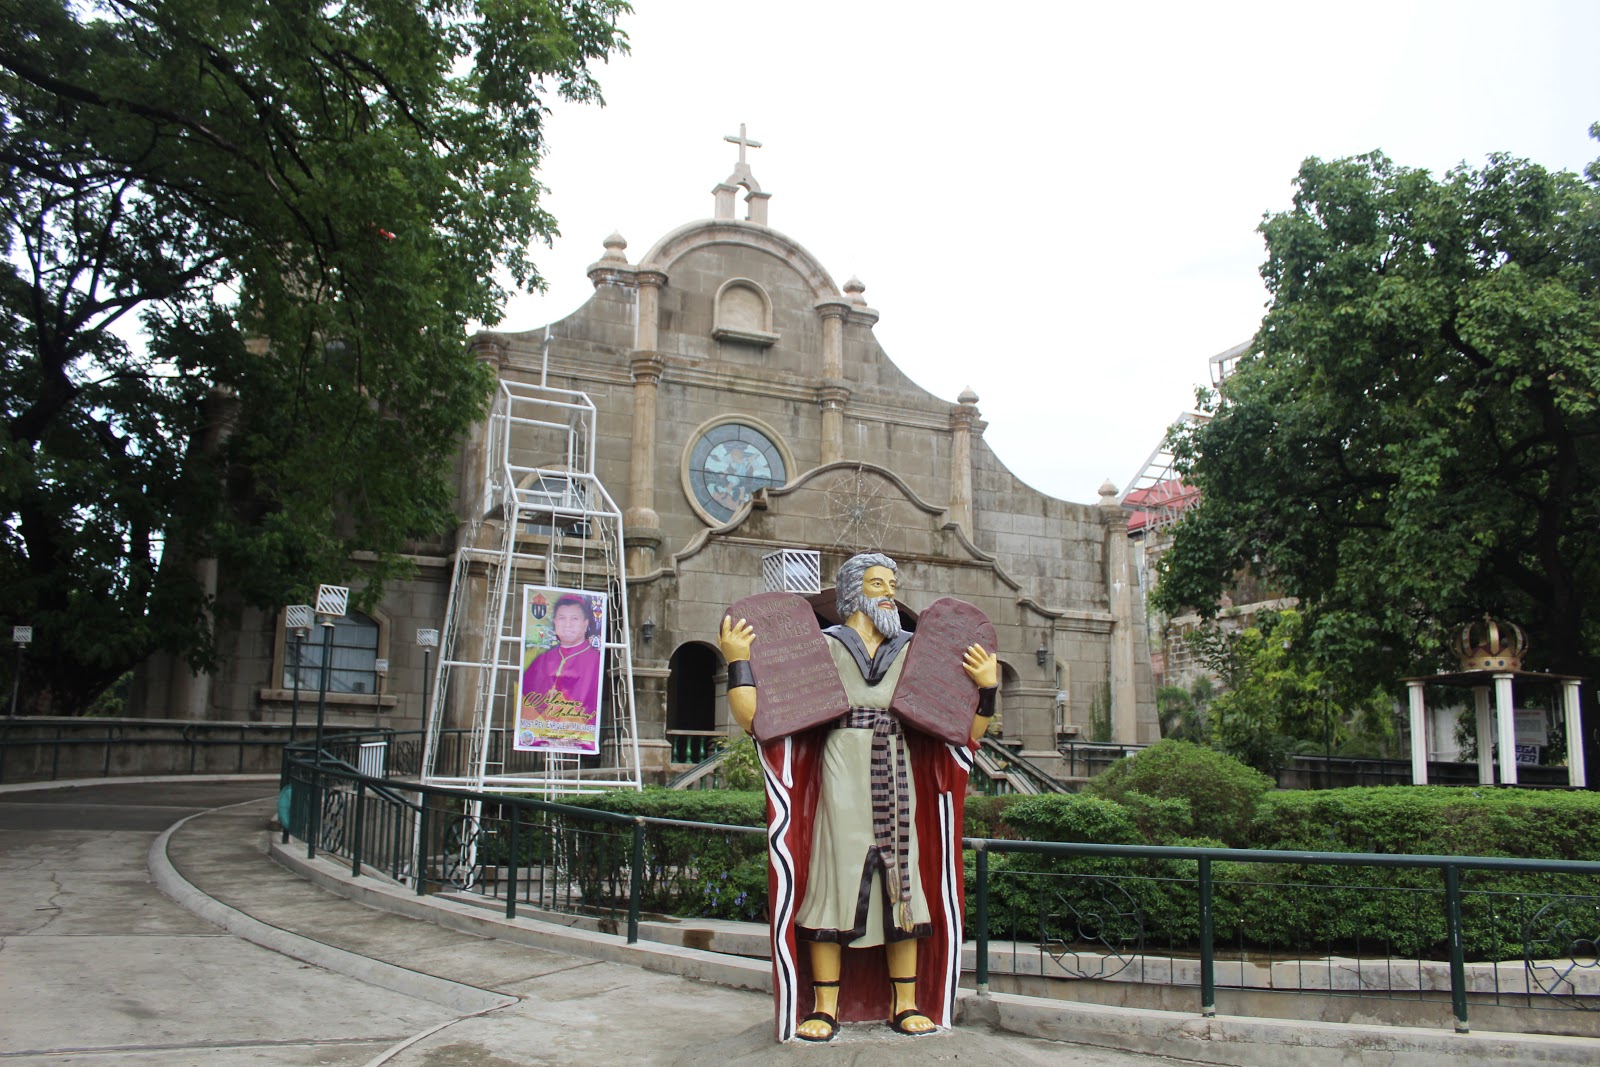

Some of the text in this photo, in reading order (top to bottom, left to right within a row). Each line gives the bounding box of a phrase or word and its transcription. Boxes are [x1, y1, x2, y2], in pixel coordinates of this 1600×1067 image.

[758, 610, 792, 630] UTOS
[775, 622, 812, 639] DIYOS
[523, 691, 583, 707] Welcome
[547, 706, 596, 723] Mabuhay!
[1515, 745, 1537, 754] EGA
[1515, 753, 1537, 763] VER
